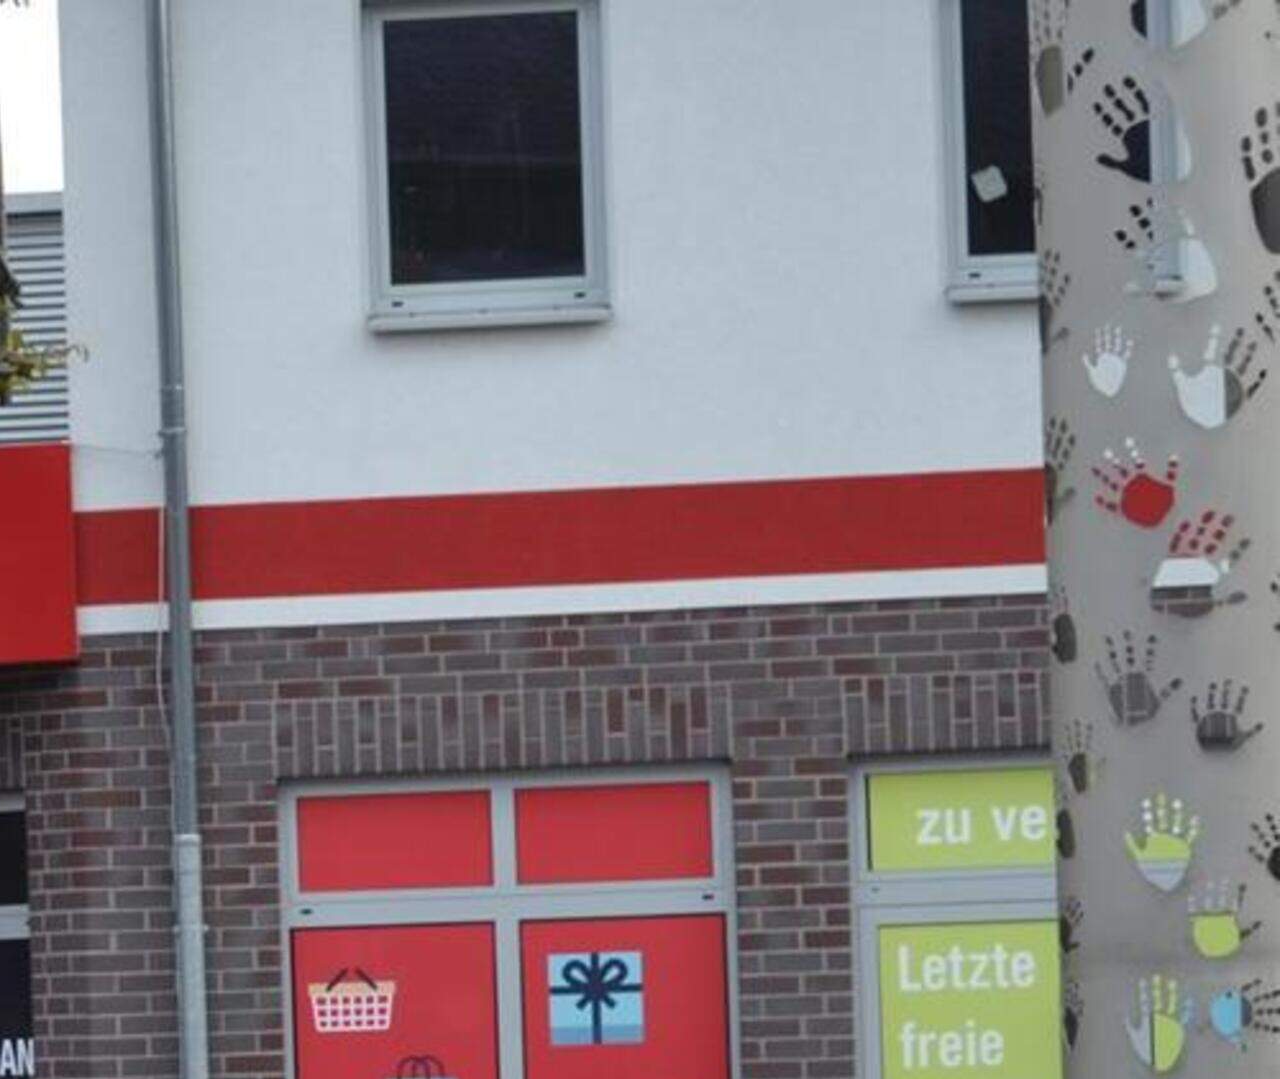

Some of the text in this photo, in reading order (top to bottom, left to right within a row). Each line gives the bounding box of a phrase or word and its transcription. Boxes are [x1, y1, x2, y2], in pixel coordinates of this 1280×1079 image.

[917, 803, 1053, 845] zu ve
[899, 944, 1036, 992] Letzte
[900, 1019, 1004, 1070] freie
